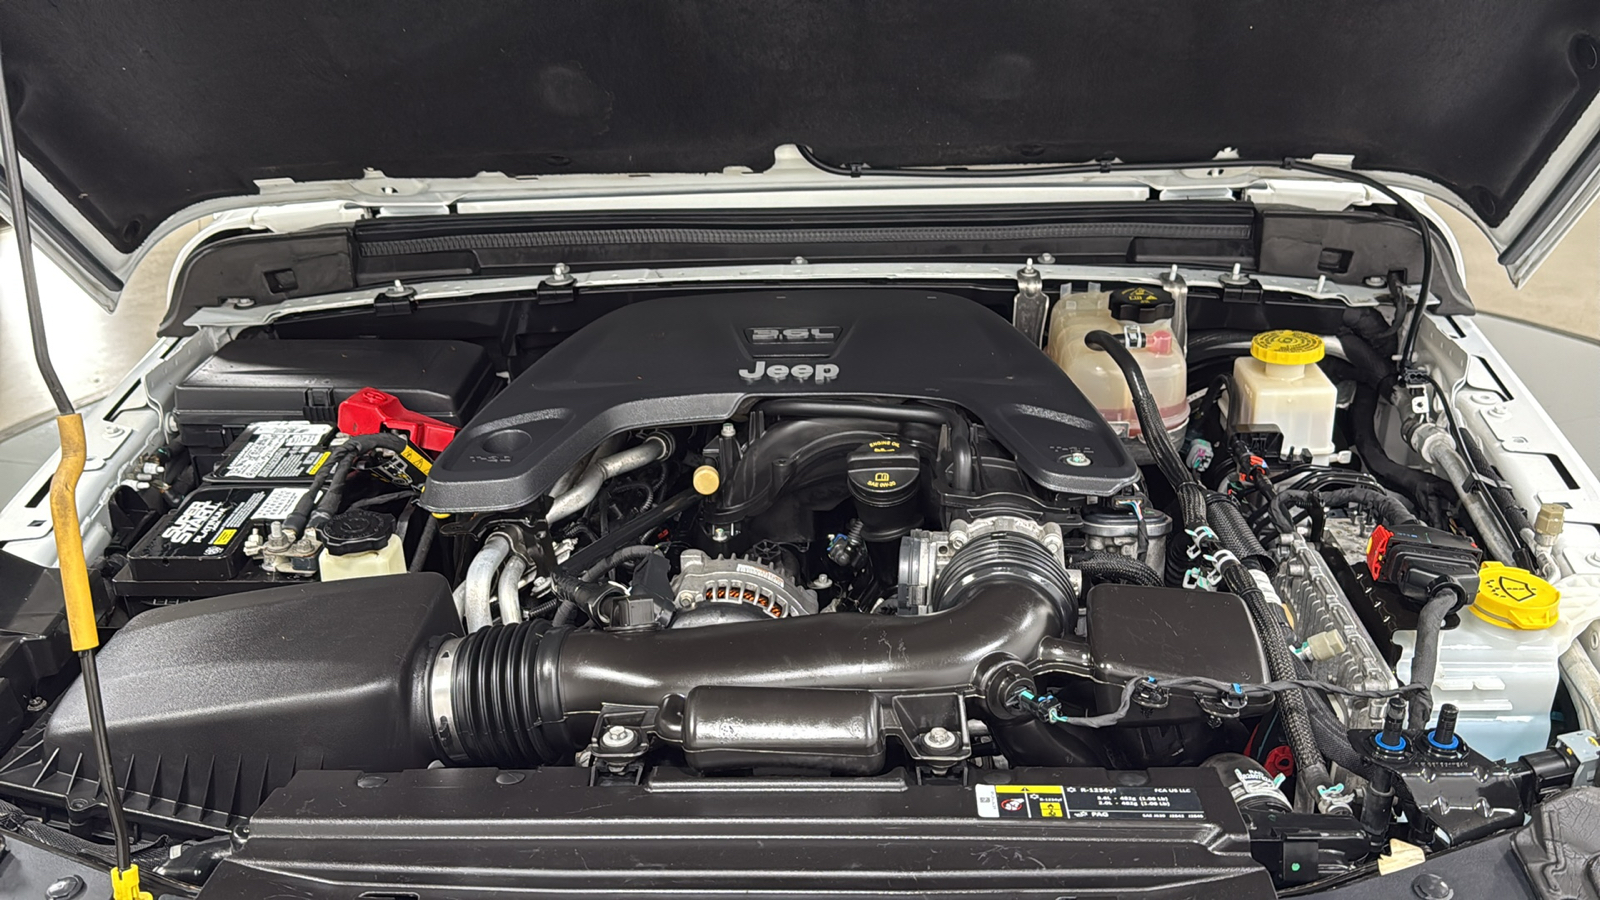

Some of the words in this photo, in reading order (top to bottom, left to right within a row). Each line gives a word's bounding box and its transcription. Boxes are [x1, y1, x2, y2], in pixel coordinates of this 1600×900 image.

[738, 361, 840, 384] Jeep
[161, 500, 209, 538] SUPER
[170, 500, 221, 544] START
